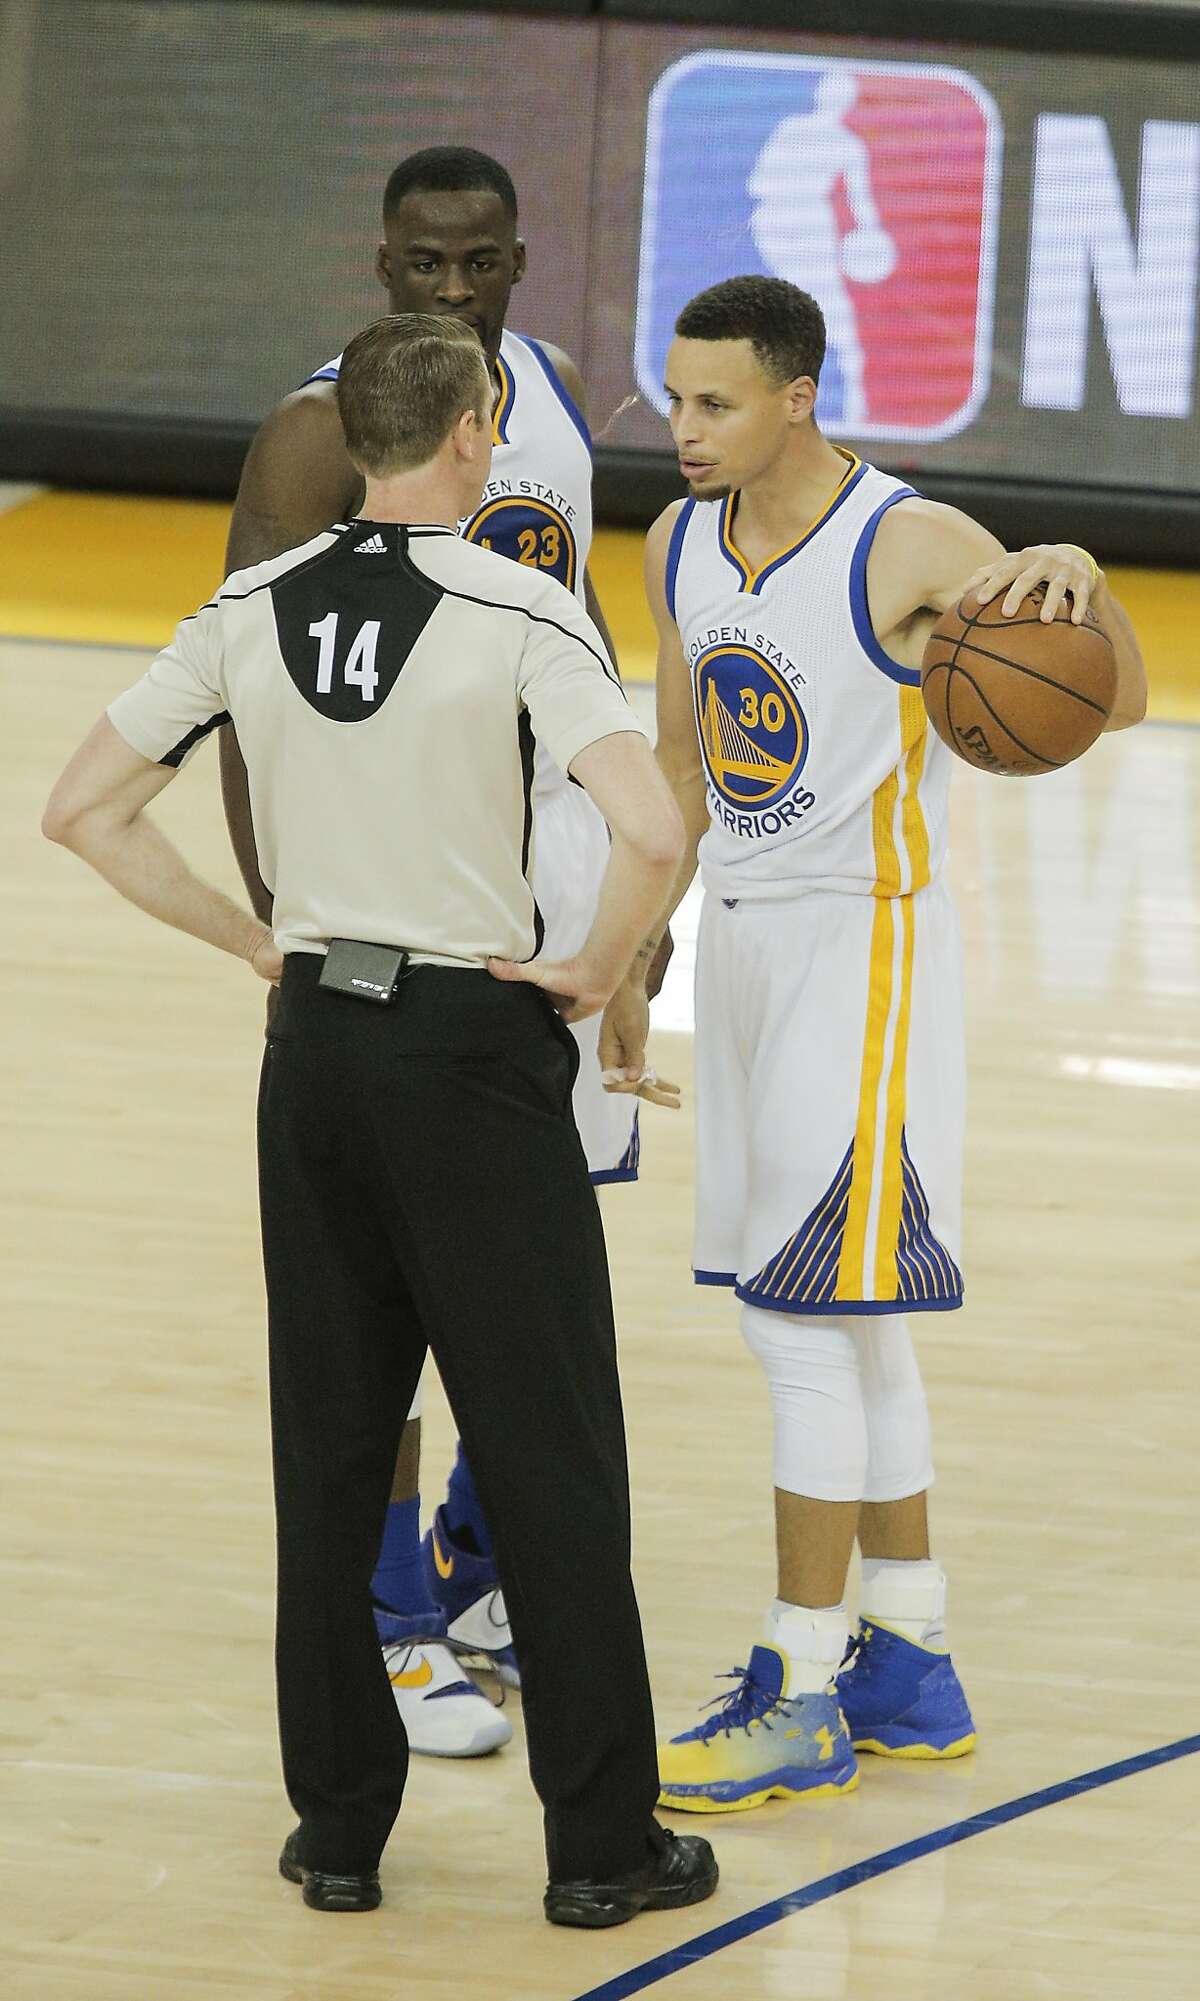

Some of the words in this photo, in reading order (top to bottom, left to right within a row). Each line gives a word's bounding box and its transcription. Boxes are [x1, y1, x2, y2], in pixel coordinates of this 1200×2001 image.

[1022, 112, 1200, 418] N
[520, 480, 577, 522] STATE
[353, 545, 388, 553] adidas
[517, 525, 560, 568] 23
[308, 612, 381, 701] 14
[754, 634, 806, 690] STATE
[738, 687, 786, 733] 30
